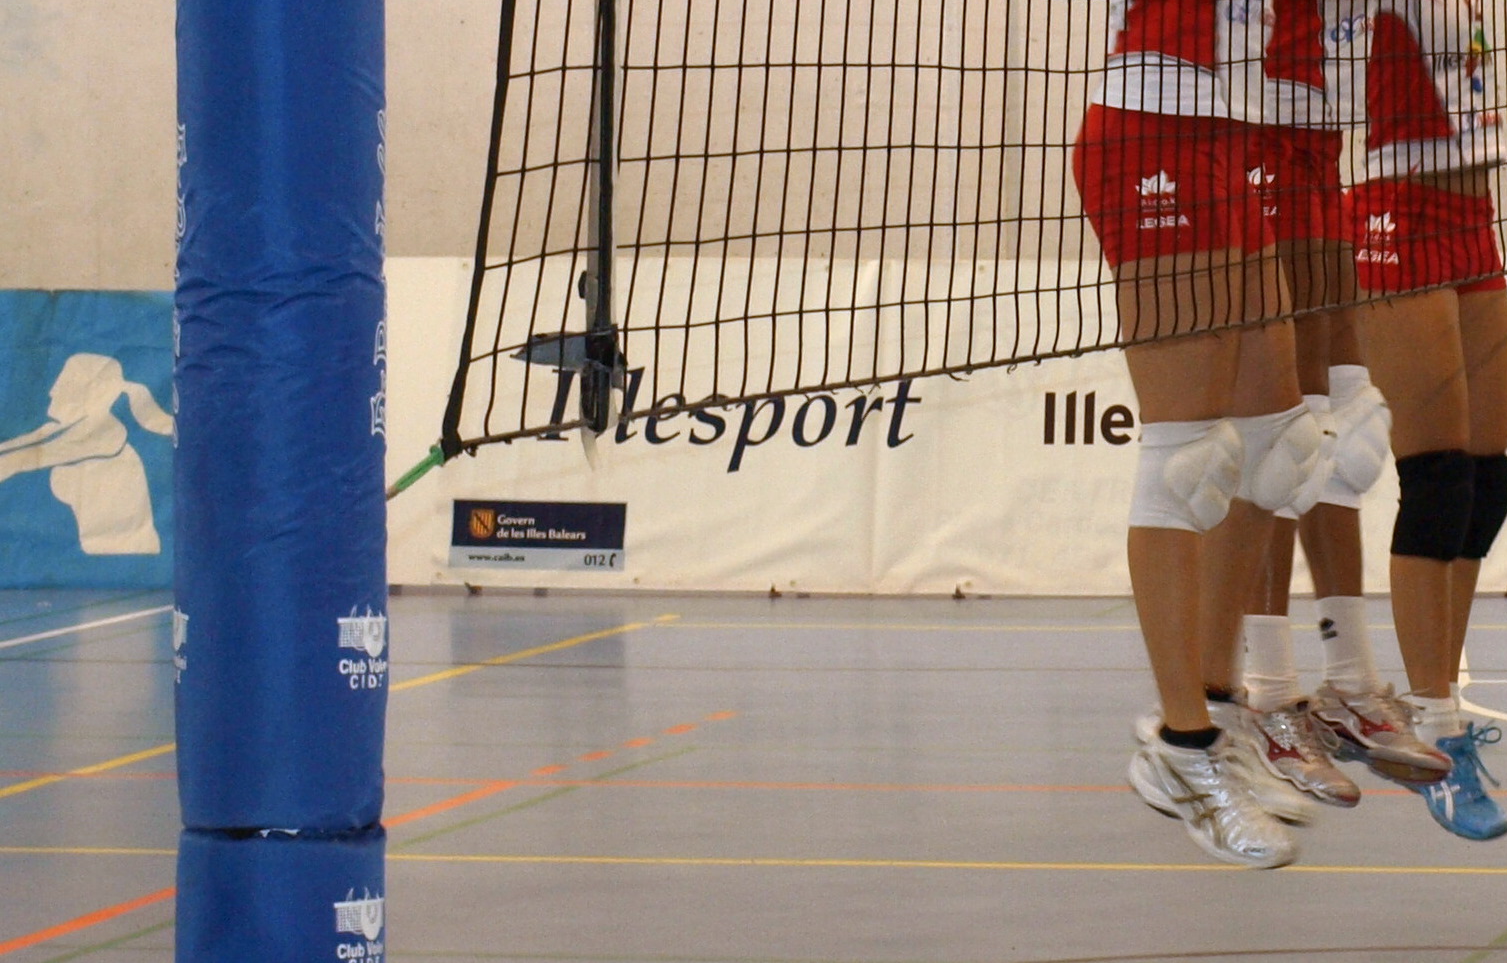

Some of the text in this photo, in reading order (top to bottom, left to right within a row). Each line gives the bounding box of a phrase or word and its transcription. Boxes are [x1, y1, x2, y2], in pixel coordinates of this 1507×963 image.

[537, 366, 1142, 473] Ilesport Ille
[496, 513, 536, 526] Govern
[496, 528, 509, 539] de
[511, 528, 525, 540] les
[548, 529, 587, 541] Balears
[583, 554, 606, 567] 012
[339, 658, 368, 675] Club
[337, 942, 366, 959] Club
